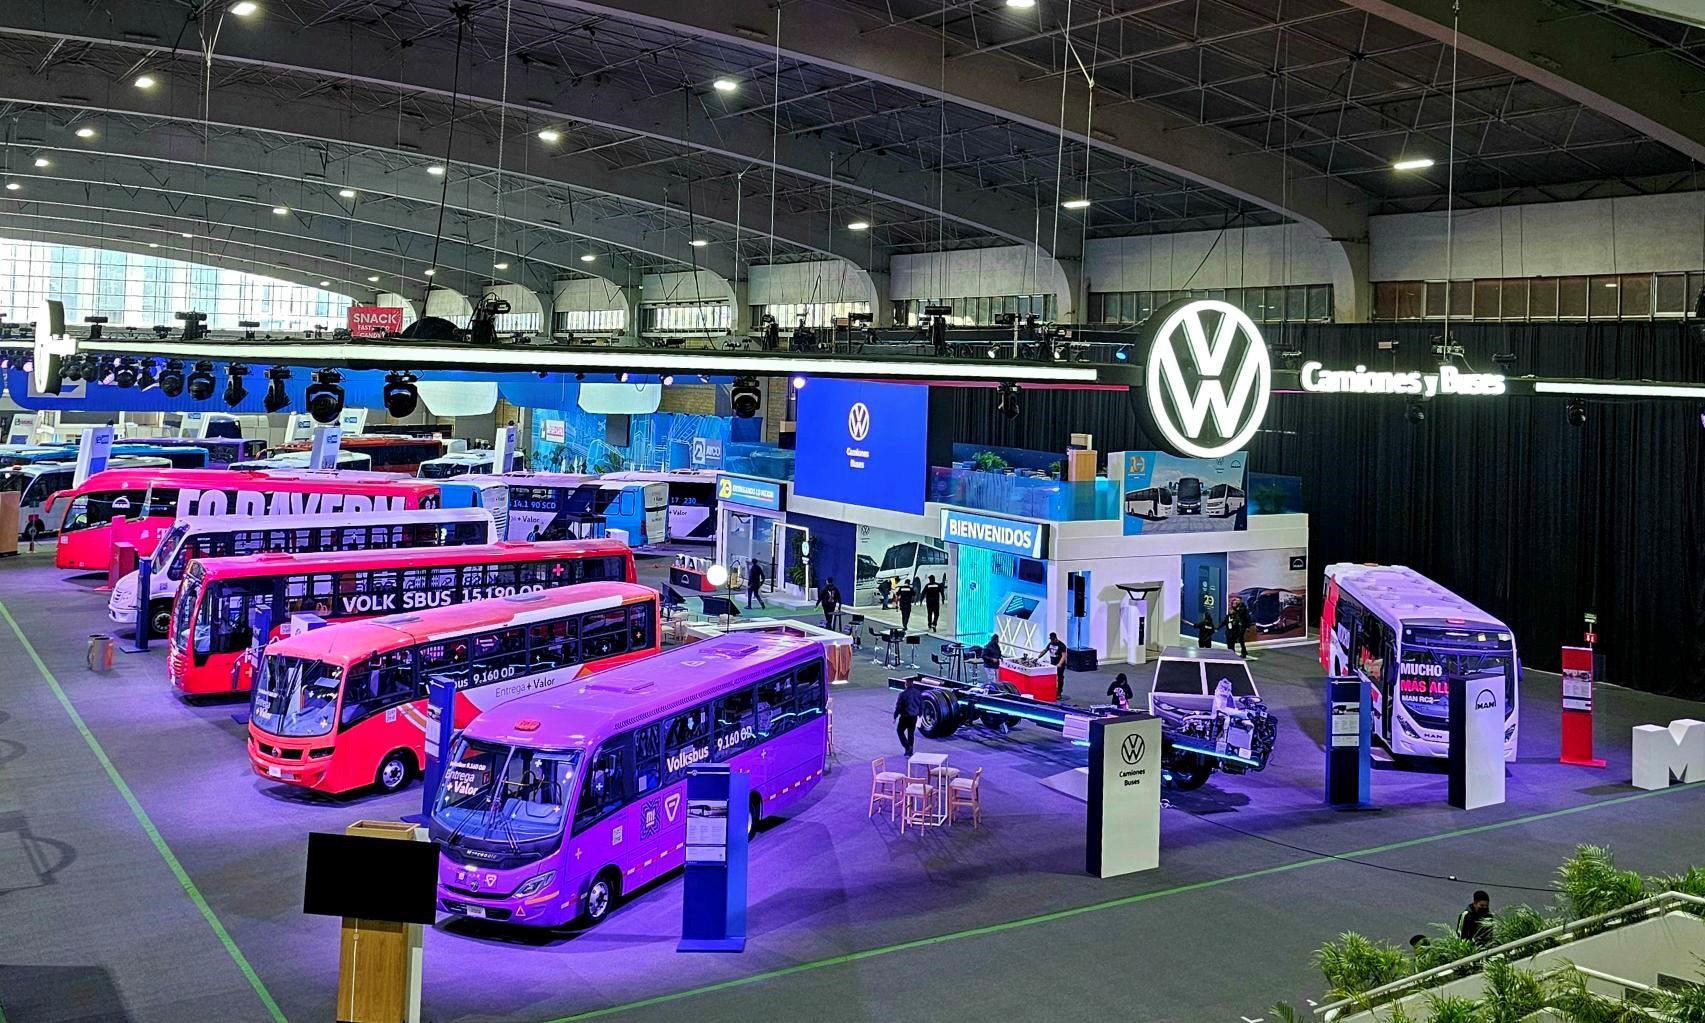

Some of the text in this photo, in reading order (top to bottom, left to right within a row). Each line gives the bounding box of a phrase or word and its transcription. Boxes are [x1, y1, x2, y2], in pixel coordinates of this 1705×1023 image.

[353, 313, 397, 324] SNACK
[1301, 361, 1506, 397] Camiones y Buses
[522, 515, 540, 523] Valor
[949, 519, 1032, 549] BIENVENIDOS
[473, 668, 499, 685] 9.160
[500, 666, 515, 678] OD
[1400, 662, 1443, 677] MUCHO
[495, 683, 526, 698] Entrega
[533, 677, 556, 689] Valor
[1400, 677, 1427, 693] MÁS
[1401, 695, 1419, 703] MAN
[666, 745, 709, 773] Volksbus
[717, 729, 740, 752] 9.160
[445, 768, 476, 782] Entrega
[1119, 769, 1146, 778] Camiones
[454, 780, 479, 796] Valor
[1124, 779, 1141, 787] Buses
